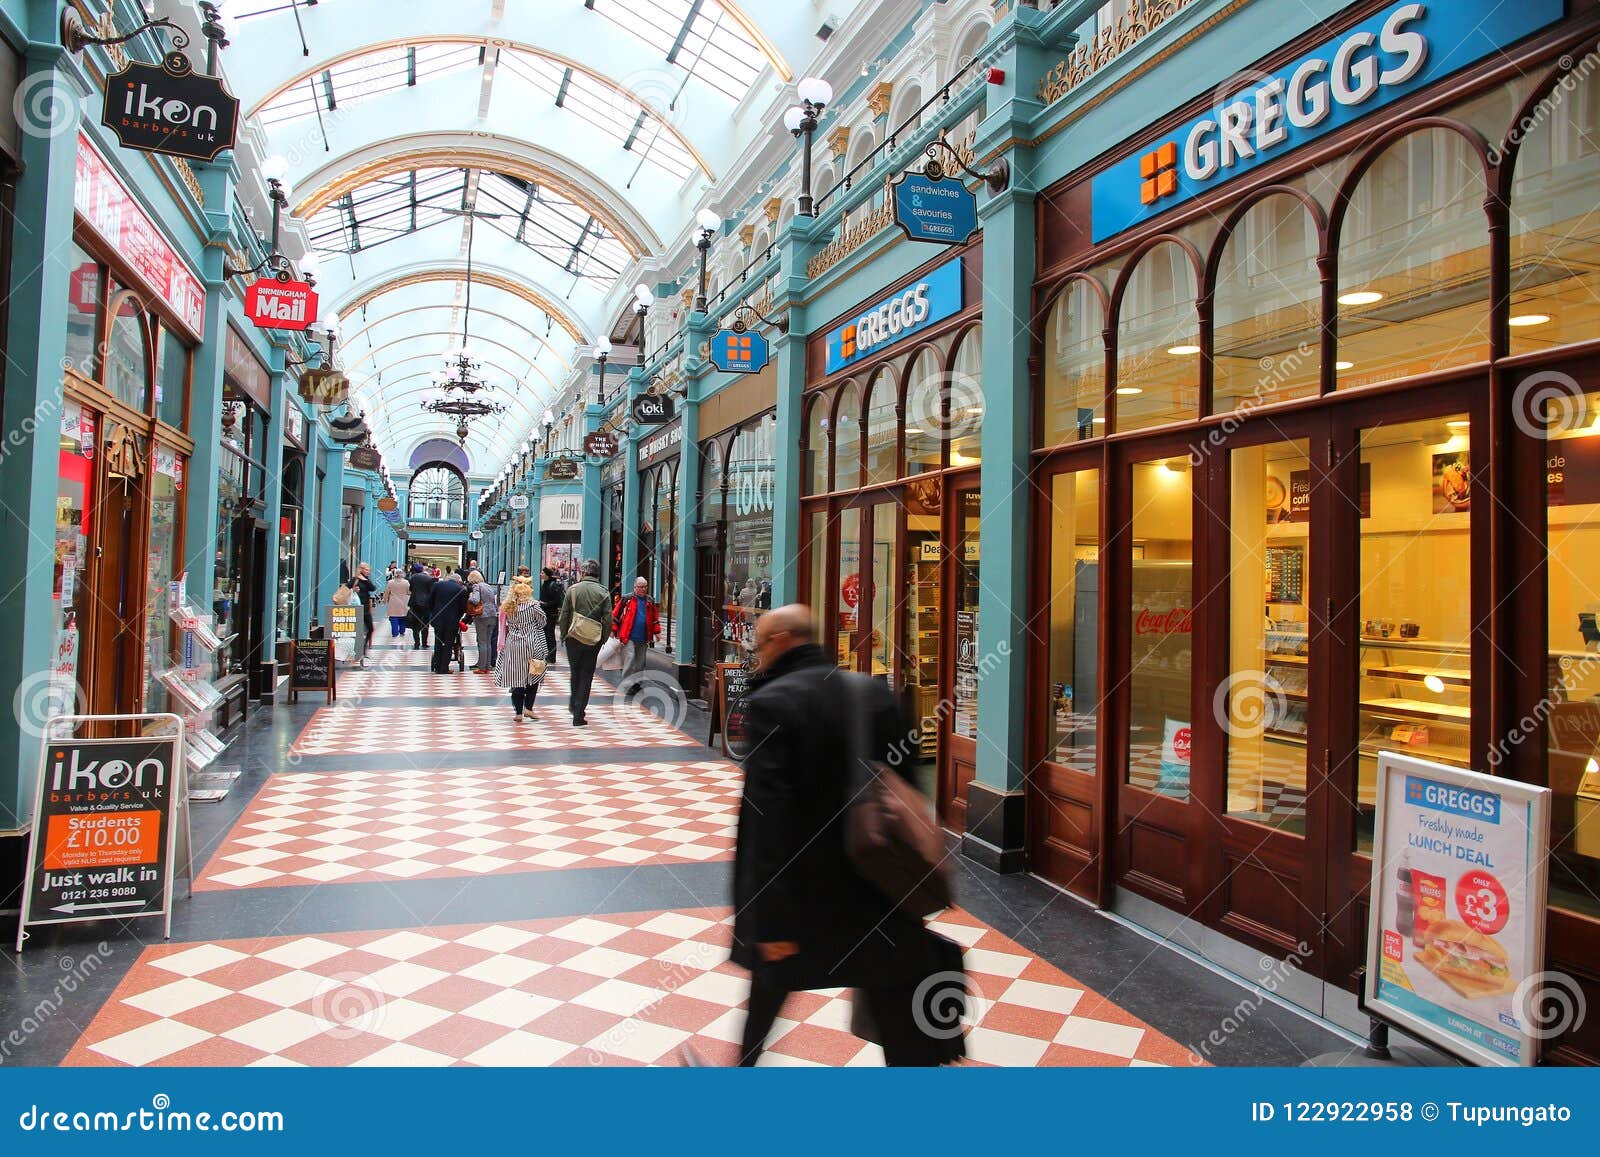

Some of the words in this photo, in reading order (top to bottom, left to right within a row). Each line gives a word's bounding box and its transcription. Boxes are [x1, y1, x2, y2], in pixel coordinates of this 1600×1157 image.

[172, 56, 182, 68] 5
[1184, 3, 1429, 180] GREGGS
[124, 82, 217, 130] ikon
[121, 117, 188, 138] barbers
[910, 184, 959, 198] sandwiches
[912, 194, 922, 207] &
[912, 207, 953, 220] savouries
[929, 225, 953, 234] GREGGS
[257, 287, 306, 299] BIRMINGHAM
[256, 295, 306, 322] Mail
[856, 283, 929, 351] GREGGS
[642, 403, 664, 415] loki
[639, 445, 649, 461] THE
[649, 433, 669, 455] WHISKY
[735, 455, 773, 516] loki
[332, 608, 356, 617] CASH
[332, 623, 355, 632] GOLD
[1136, 608, 1192, 635] Coca-Cola
[52, 750, 164, 790] ikon
[51, 790, 130, 803] barbers
[1425, 785, 1495, 817] GREGGS
[96, 803, 119, 811] Quality
[68, 816, 141, 830] Students
[1418, 814, 1453, 839] Freshly
[1455, 825, 1484, 843] made
[67, 827, 140, 848] £10.00
[62, 851, 88, 859] Monday
[1408, 832, 1452, 856] LUNCH
[1455, 845, 1495, 868] DEAL
[113, 855, 141, 863] required
[41, 872, 83, 893] Just
[87, 867, 134, 885] walk
[140, 866, 157, 882] in
[1472, 877, 1491, 887] ONLY
[61, 891, 87, 900] 0121
[89, 889, 110, 898] 236
[111, 886, 137, 896] 9080
[1465, 888, 1498, 922] £3
[1448, 1017, 1473, 1036] LUNCH
